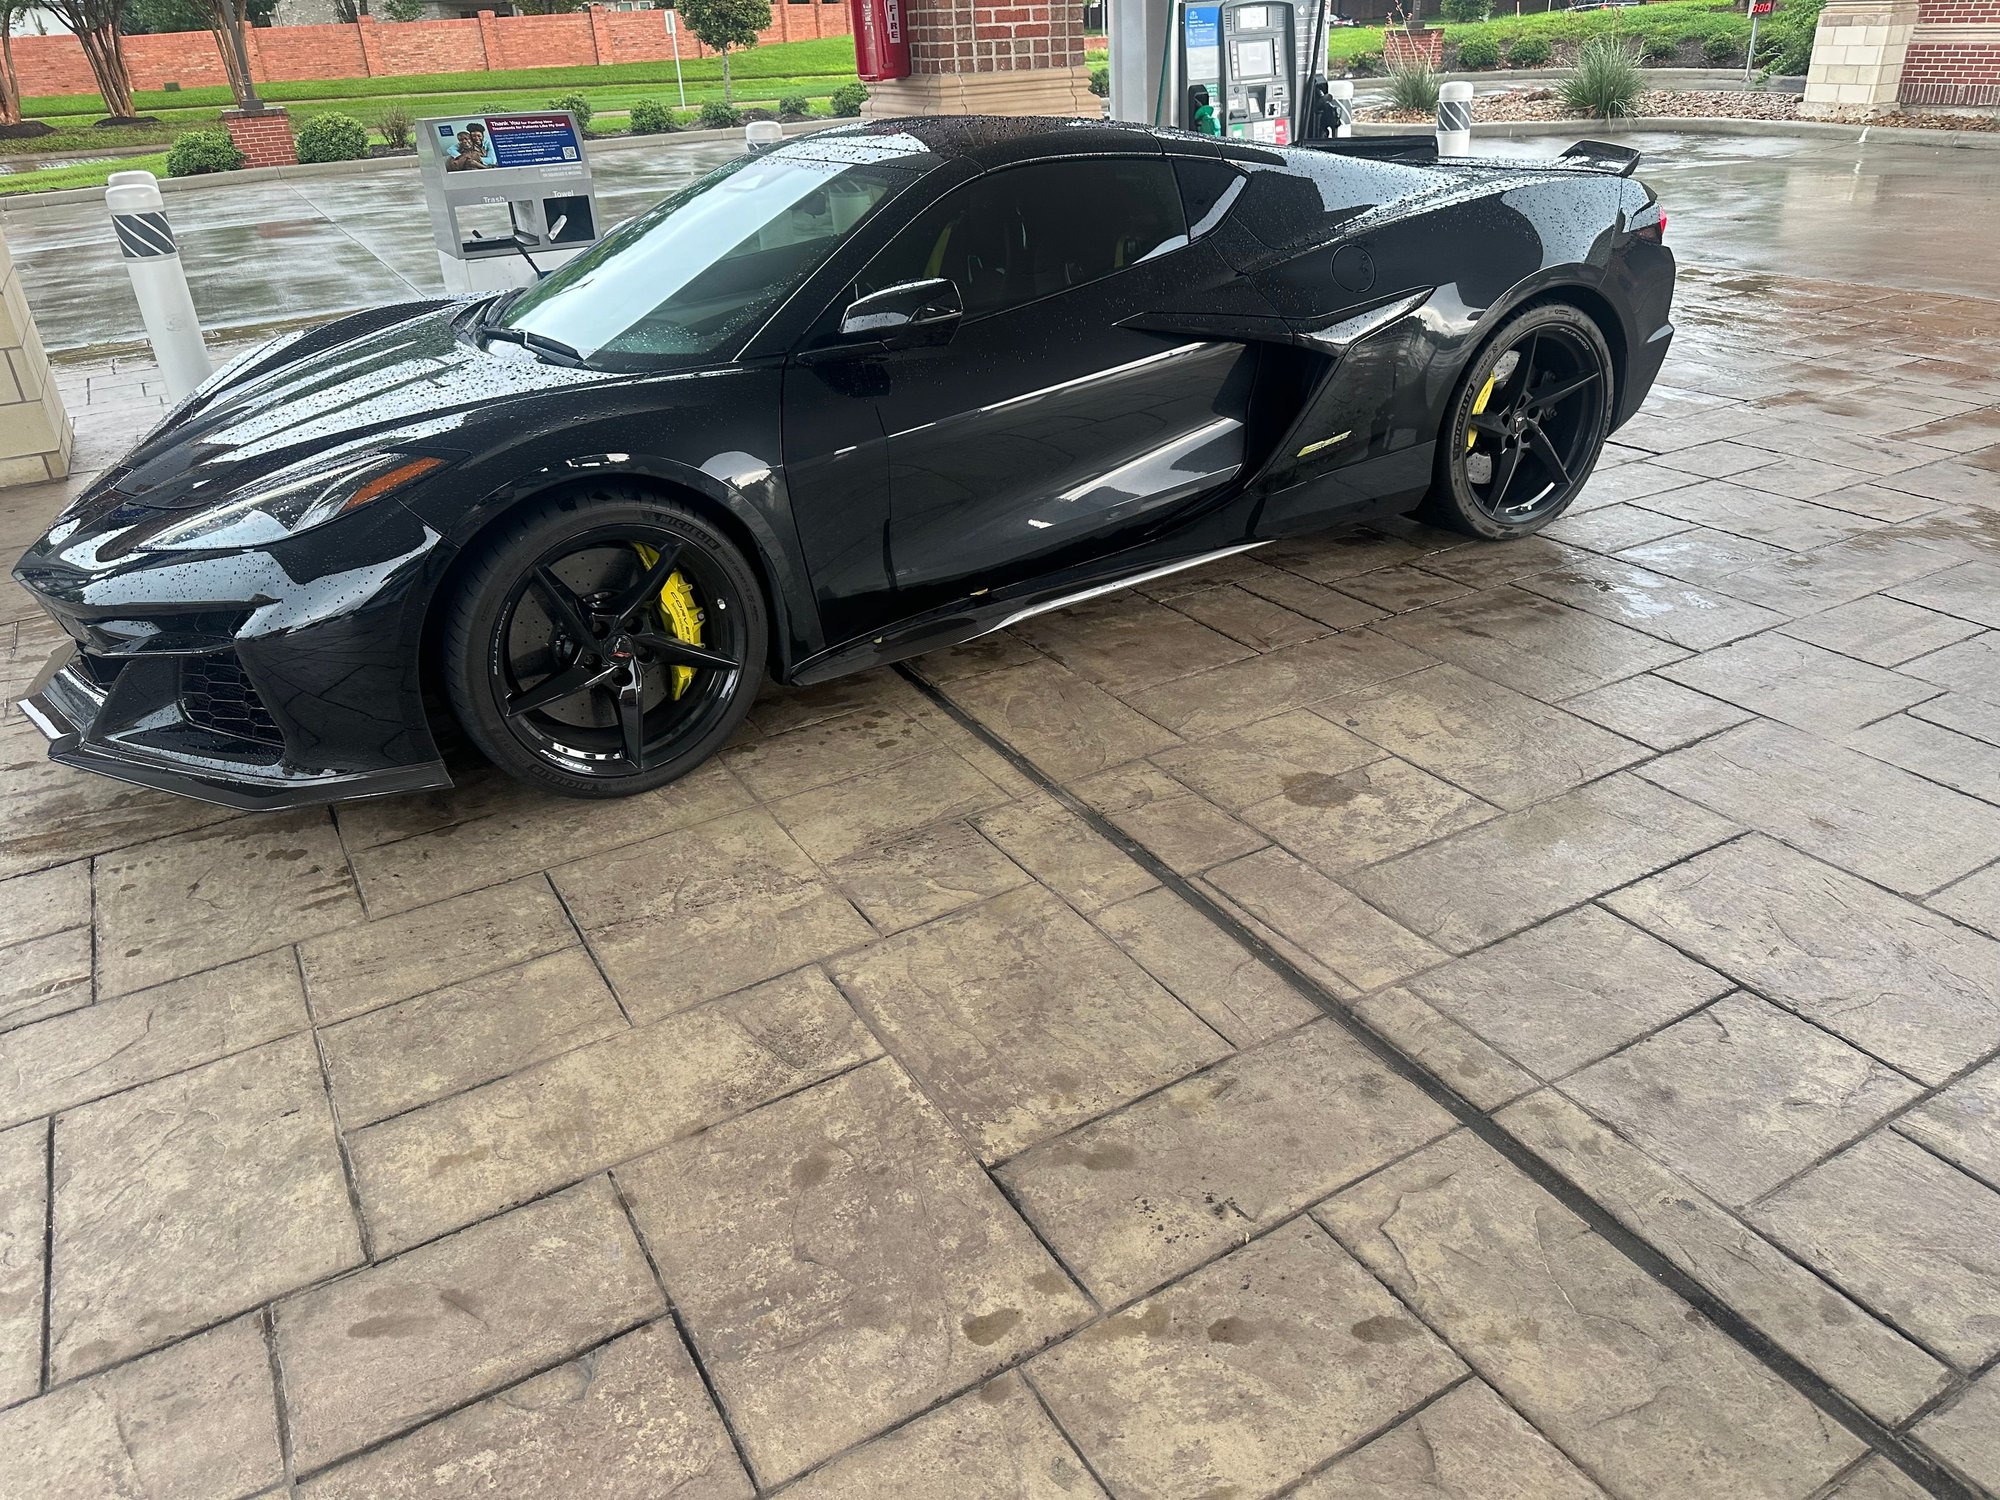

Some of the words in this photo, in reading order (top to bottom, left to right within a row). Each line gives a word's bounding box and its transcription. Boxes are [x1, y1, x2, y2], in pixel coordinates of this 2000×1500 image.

[889, 5, 899, 39] FIRE
[552, 190, 574, 198] Towel
[1454, 386, 1474, 447] MICHELIN
[659, 514, 718, 549] MICHELIN
[671, 591, 691, 642] CORVET
[494, 601, 511, 676] CORVETTE
[540, 749, 593, 771] FORGED
